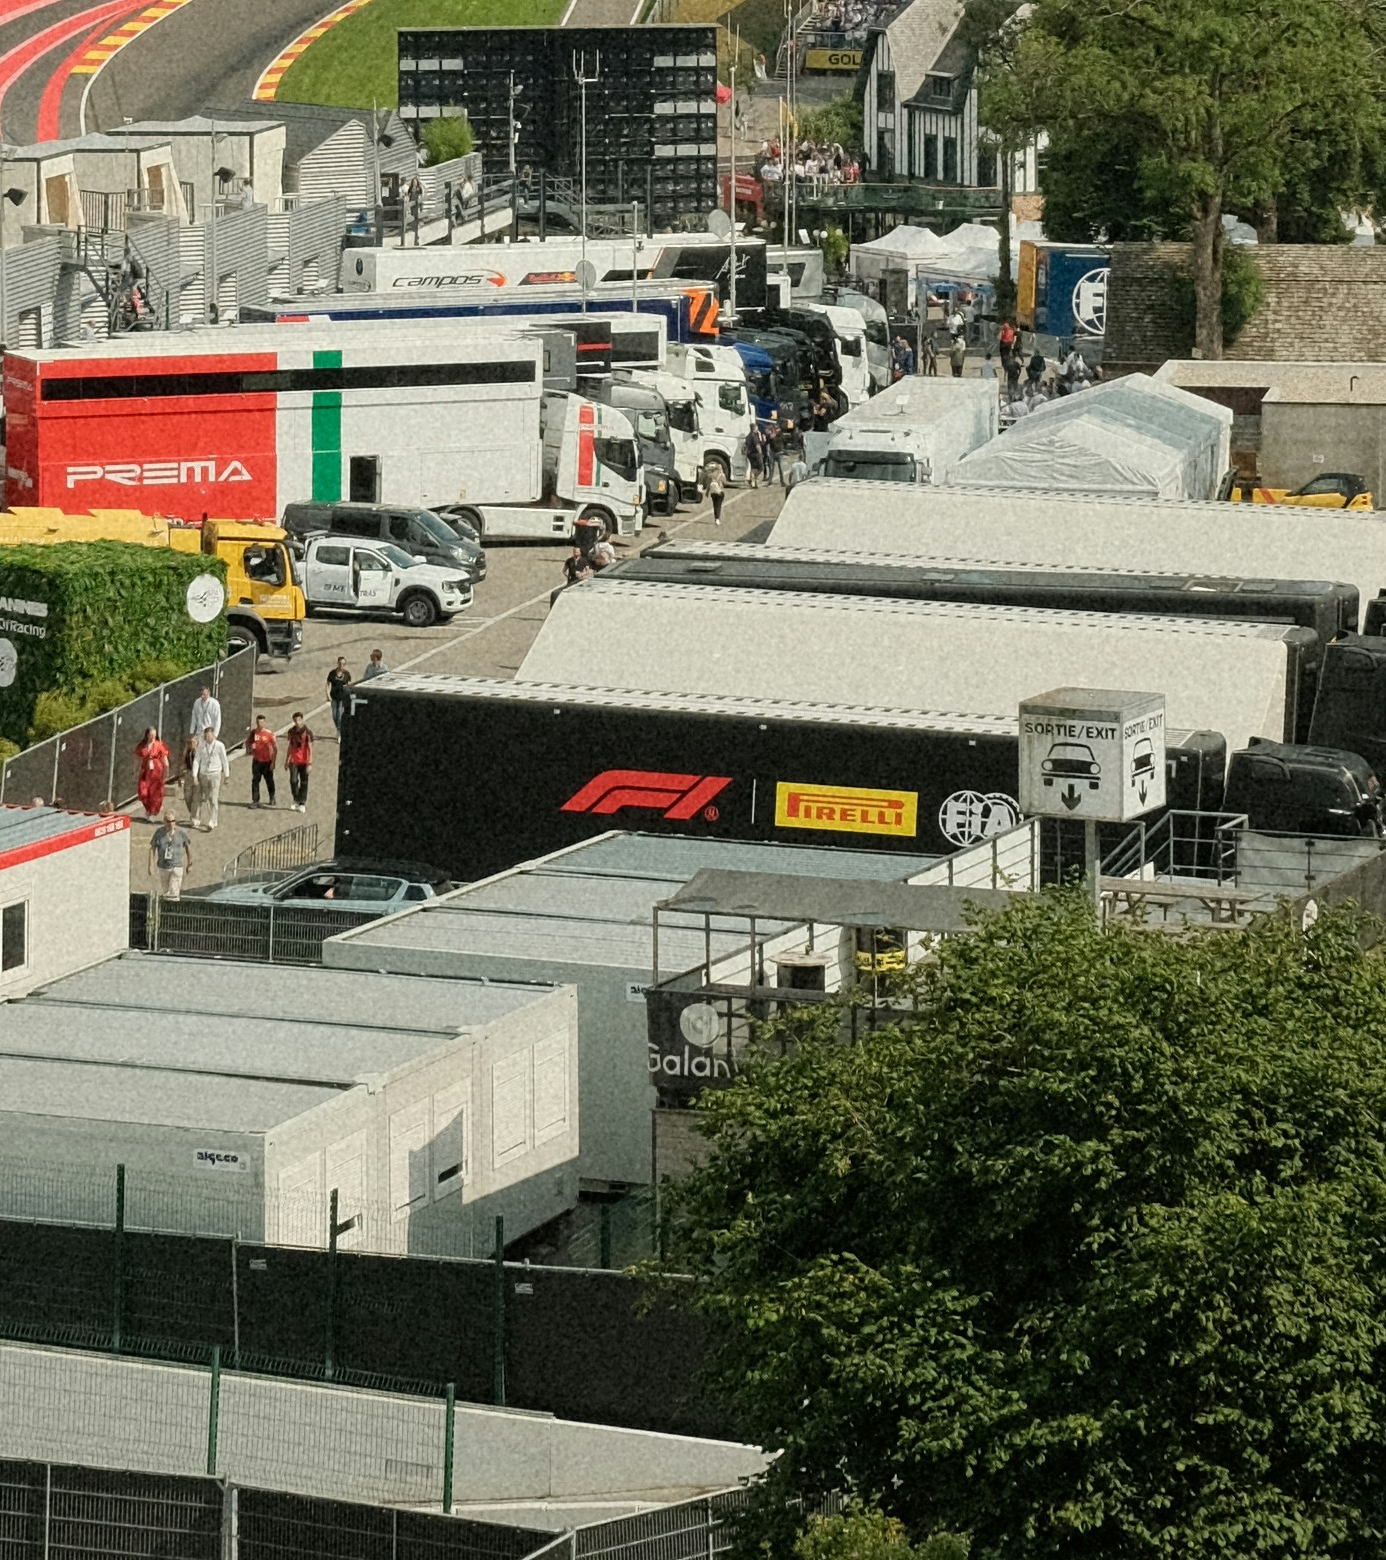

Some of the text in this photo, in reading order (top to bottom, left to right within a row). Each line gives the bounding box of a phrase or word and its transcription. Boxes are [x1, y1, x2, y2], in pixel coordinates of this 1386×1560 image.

[828, 53, 862, 66] GOL
[392, 273, 484, 289] campos
[66, 460, 253, 488] PREMA
[1025, 722, 1117, 741] SORTIE/EXIT
[1124, 713, 1163, 740] SORTIE/EXIT
[786, 791, 906, 827] PIRELLI
